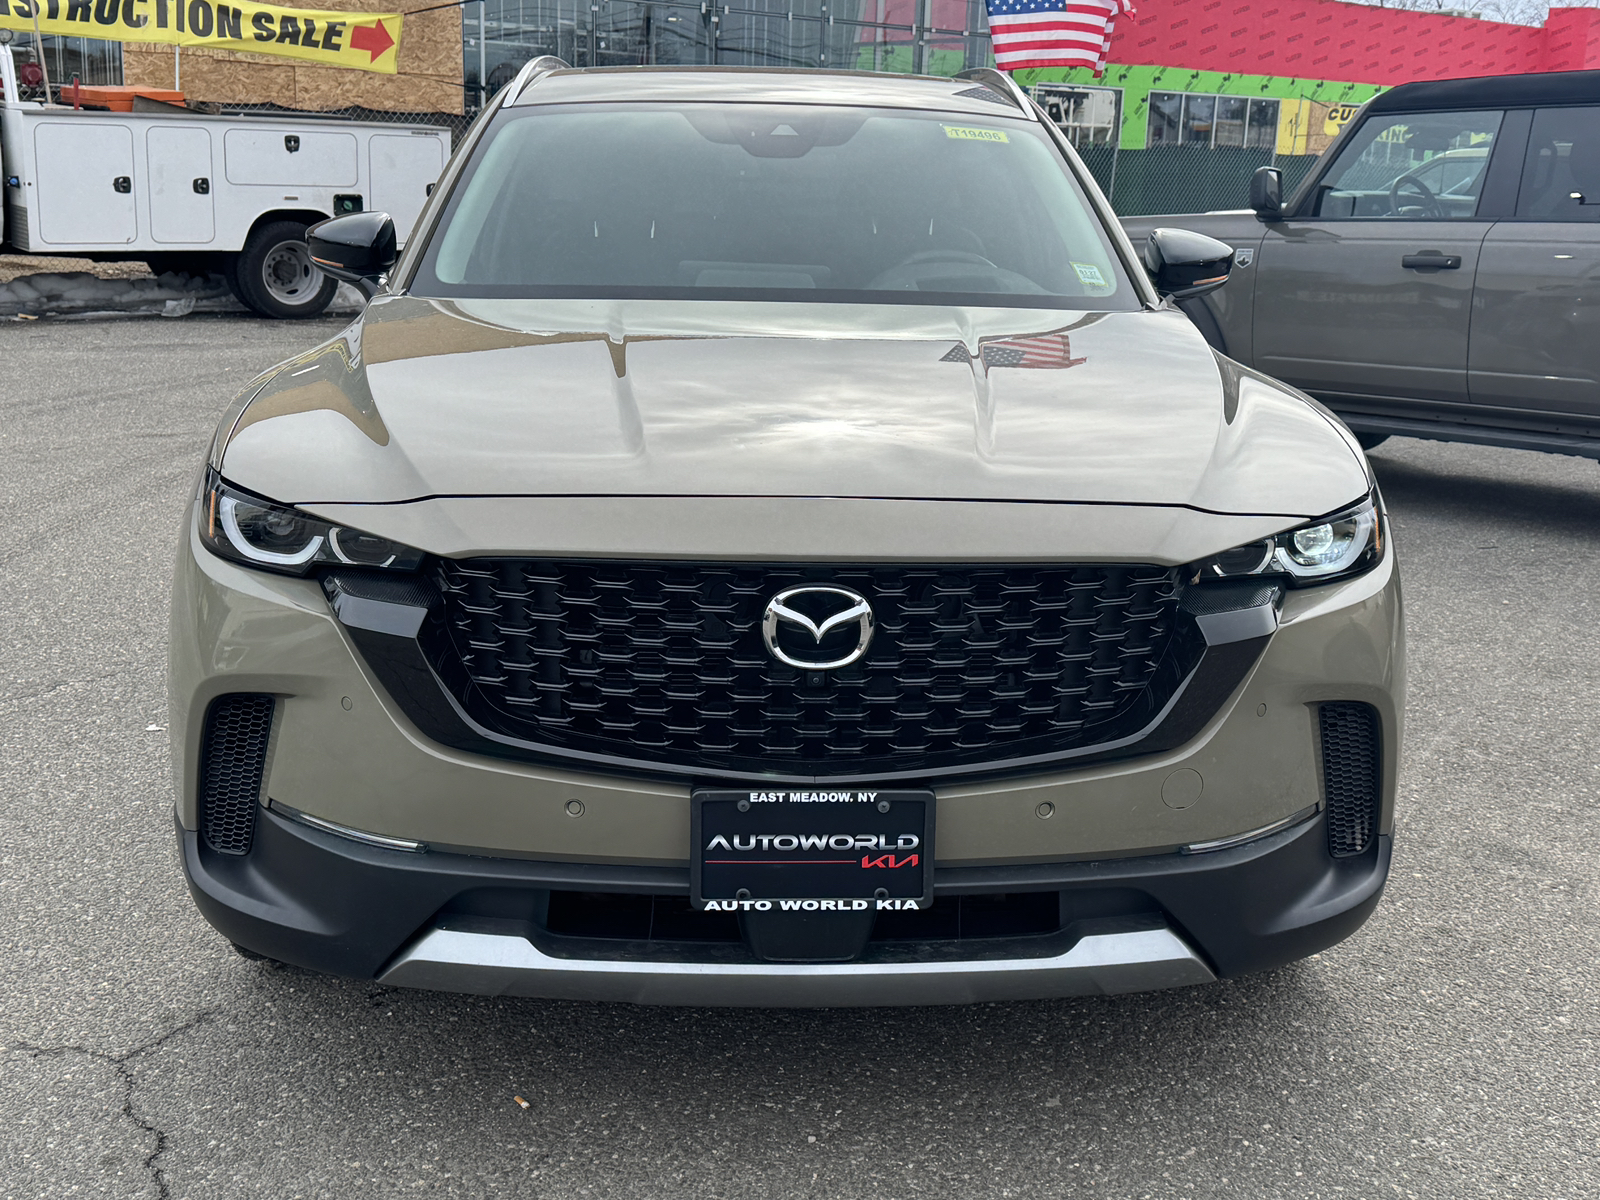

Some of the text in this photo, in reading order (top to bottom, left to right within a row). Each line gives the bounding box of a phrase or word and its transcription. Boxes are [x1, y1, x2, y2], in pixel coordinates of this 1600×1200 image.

[251, 11, 347, 52] SALE
[750, 792, 785, 803] EAST
[857, 792, 878, 803] NY
[706, 834, 920, 851] AUTOWORLD
[861, 854, 919, 869] KIA
[704, 900, 920, 911] AUTO WORLD KIA
